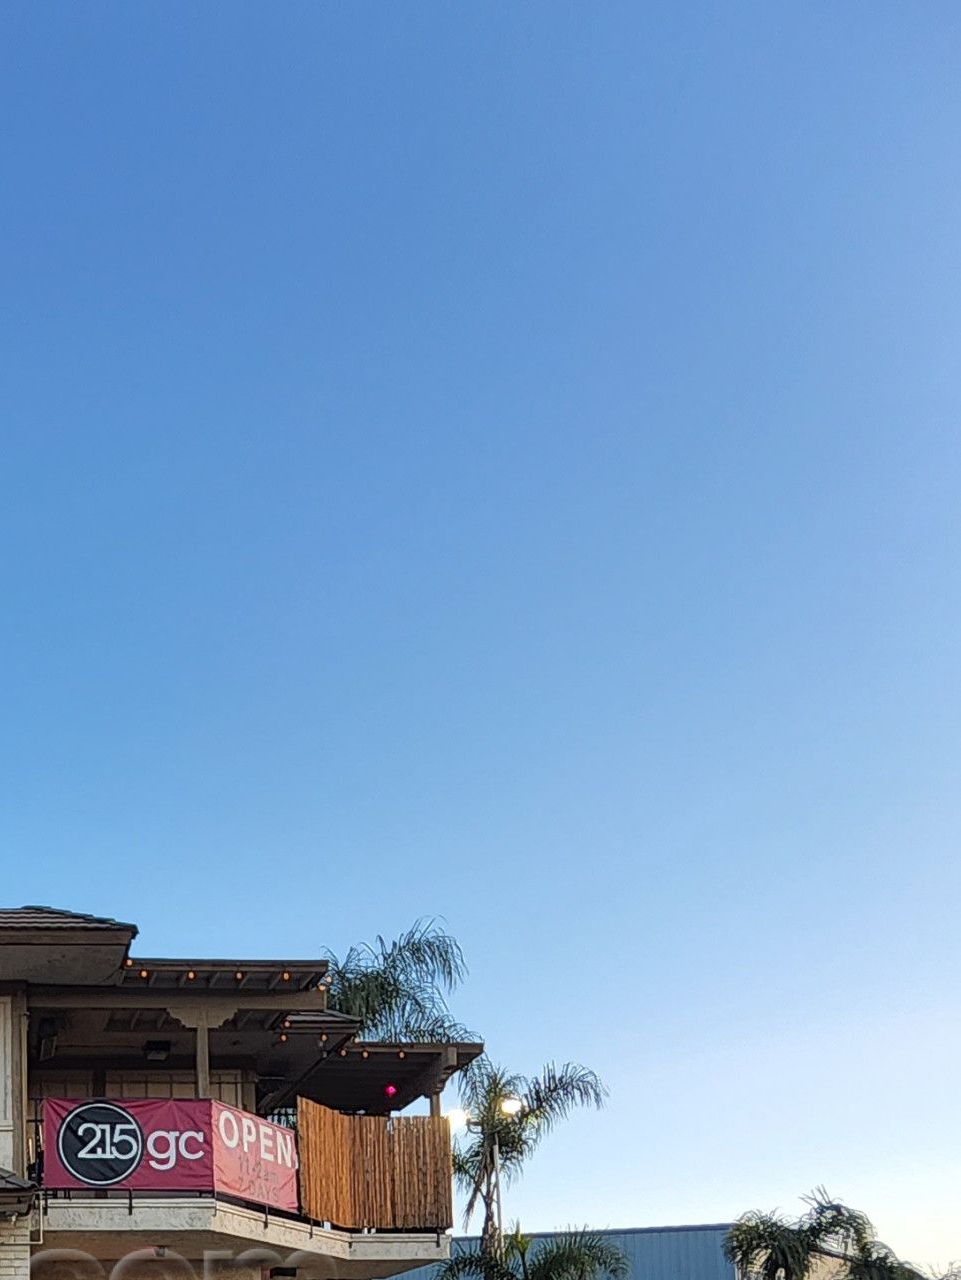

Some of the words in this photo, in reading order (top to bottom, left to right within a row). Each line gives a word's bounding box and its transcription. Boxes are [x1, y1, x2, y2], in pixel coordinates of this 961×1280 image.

[77, 1122, 138, 1159] 215
[147, 1129, 205, 1170] gc
[219, 1110, 292, 1168] OPEN
